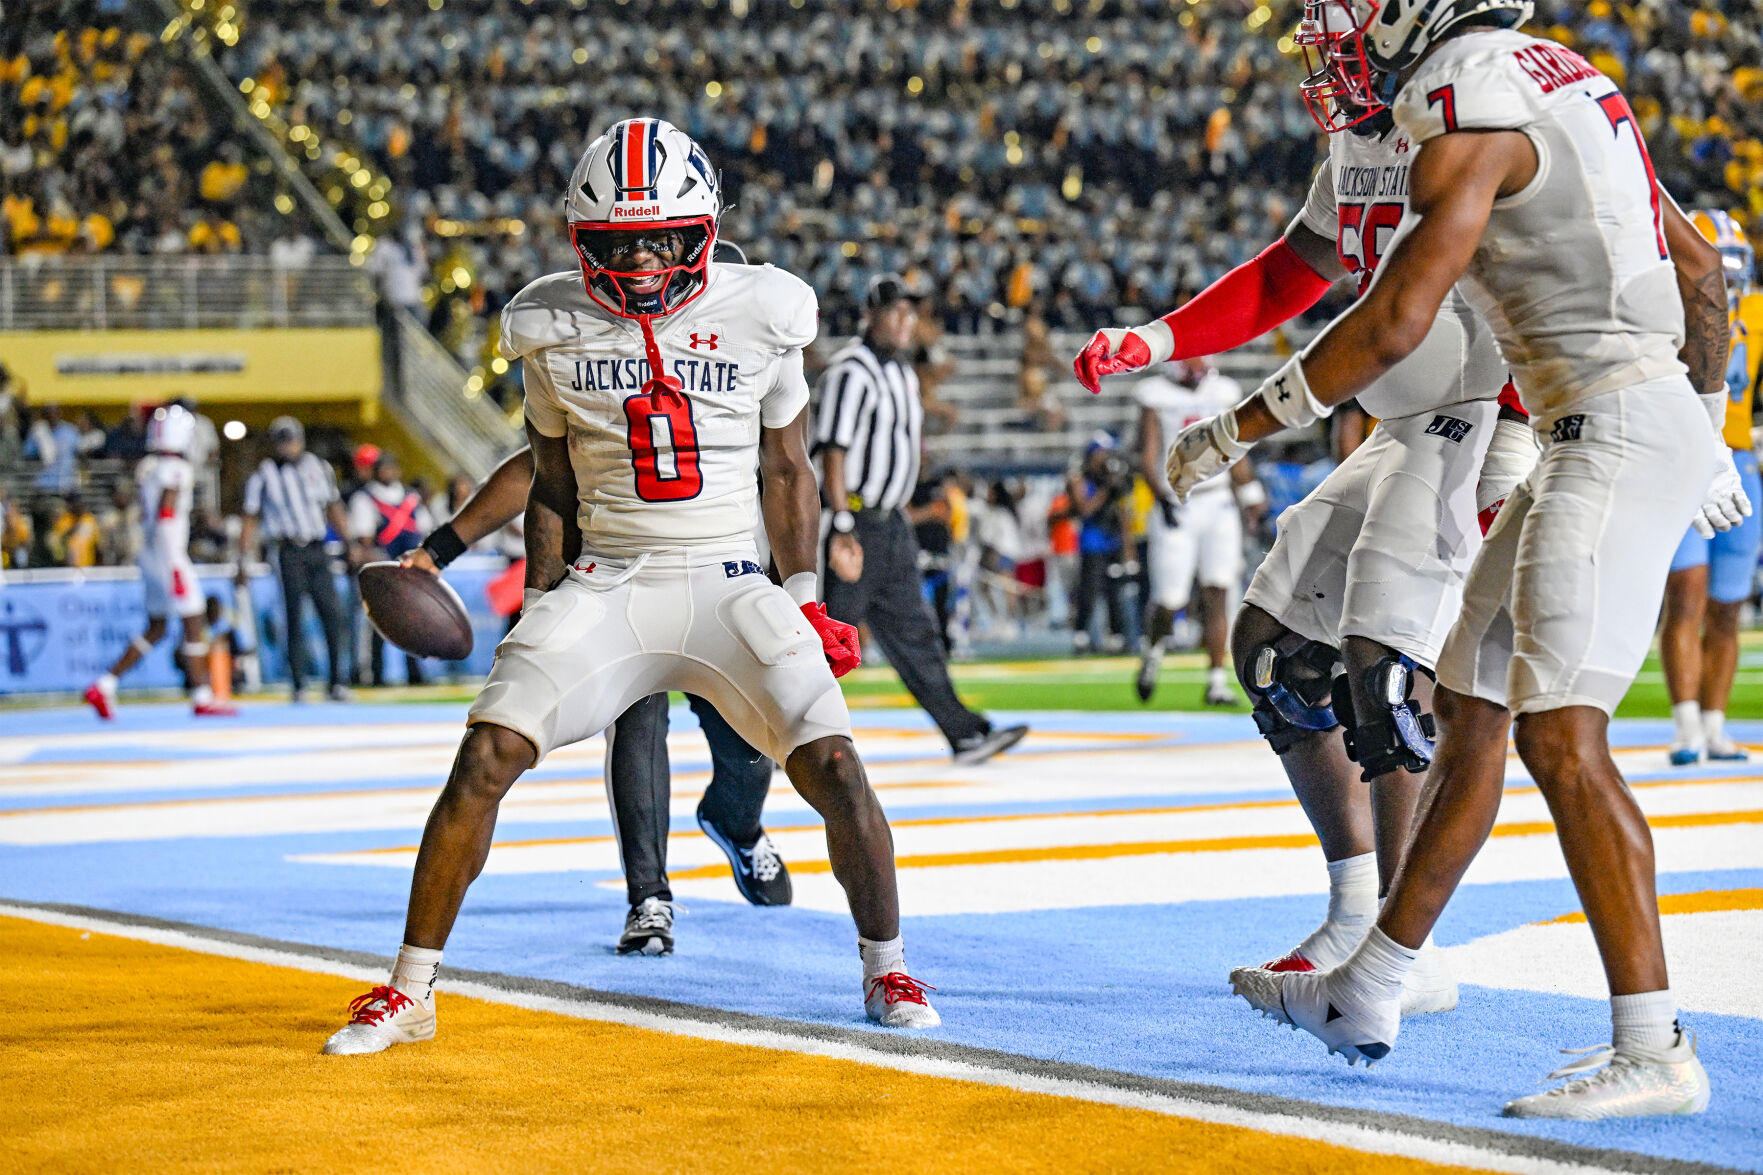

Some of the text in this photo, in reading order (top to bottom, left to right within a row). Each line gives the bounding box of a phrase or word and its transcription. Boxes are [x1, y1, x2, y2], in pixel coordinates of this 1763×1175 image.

[1427, 83, 1458, 133] 7
[1337, 166, 1380, 196] JACKSON
[1595, 91, 1668, 260] 7
[615, 206, 660, 217] Riddell
[637, 299, 658, 308] Riddell
[572, 359, 739, 392] JACKSO STATE
[623, 393, 703, 502] 0
